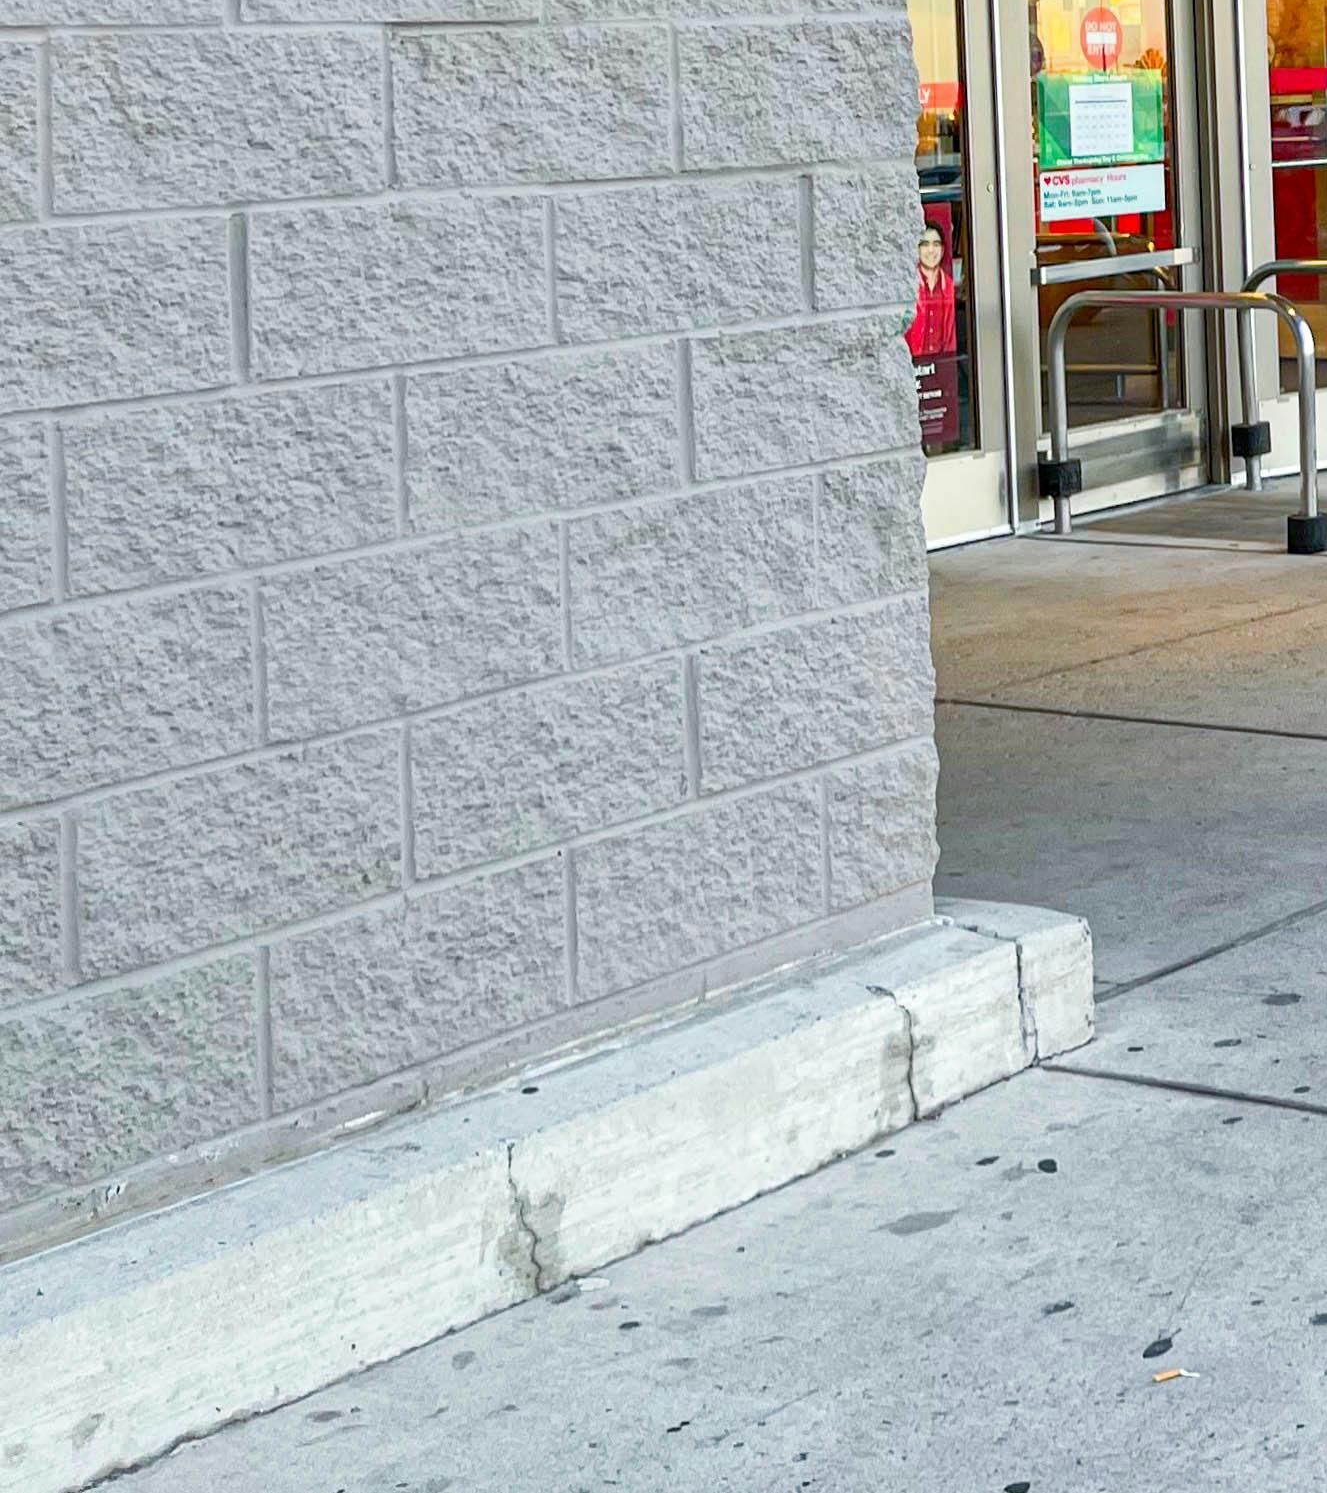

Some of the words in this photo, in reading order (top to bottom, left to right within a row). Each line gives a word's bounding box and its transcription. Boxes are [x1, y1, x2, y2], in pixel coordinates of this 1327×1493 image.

[1085, 21, 1098, 31] DO
[1100, 21, 1116, 31] NOT
[918, 88, 931, 104] LY
[1052, 175, 1070, 186] CVS
[1072, 175, 1104, 186] pharmacy
[915, 363, 935, 377] tart
